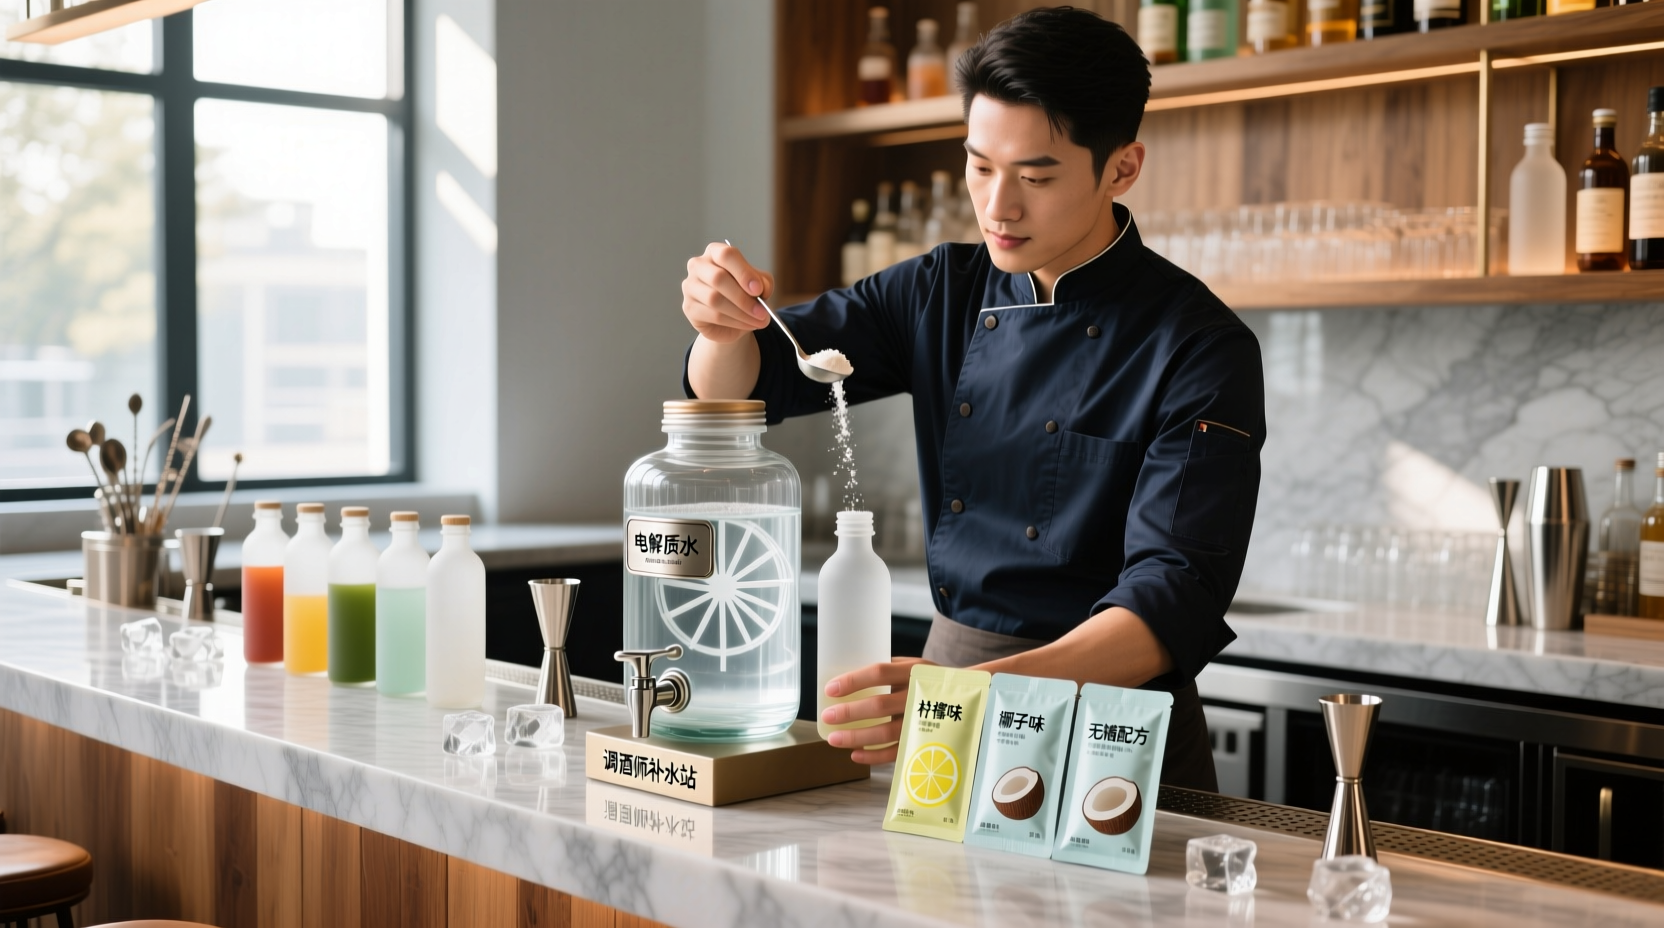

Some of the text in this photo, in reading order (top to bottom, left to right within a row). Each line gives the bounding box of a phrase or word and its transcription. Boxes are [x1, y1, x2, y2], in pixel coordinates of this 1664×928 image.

[634, 530, 699, 557] 电解质水
[603, 749, 698, 790] 调酒师补水站
